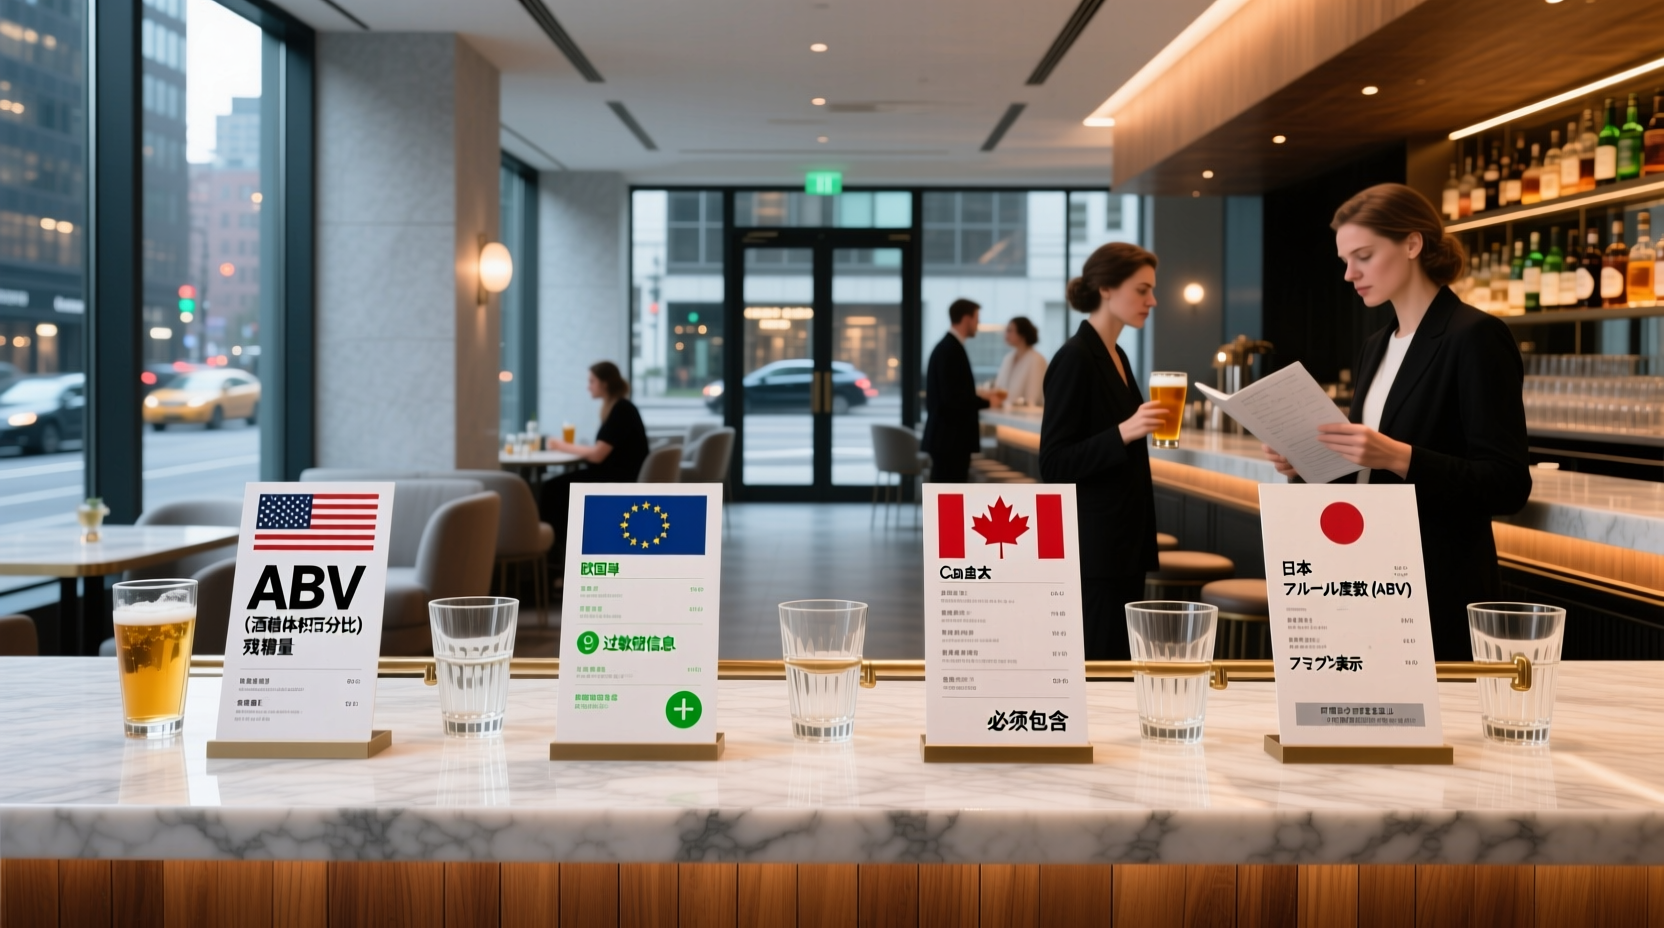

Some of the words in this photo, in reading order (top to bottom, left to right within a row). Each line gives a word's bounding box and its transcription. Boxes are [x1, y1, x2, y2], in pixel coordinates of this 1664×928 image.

[1282, 559, 1313, 576] 日本
[246, 564, 367, 611] ABV
[1371, 580, 1412, 599] (ABV)
[987, 709, 1069, 732] 必须包含
